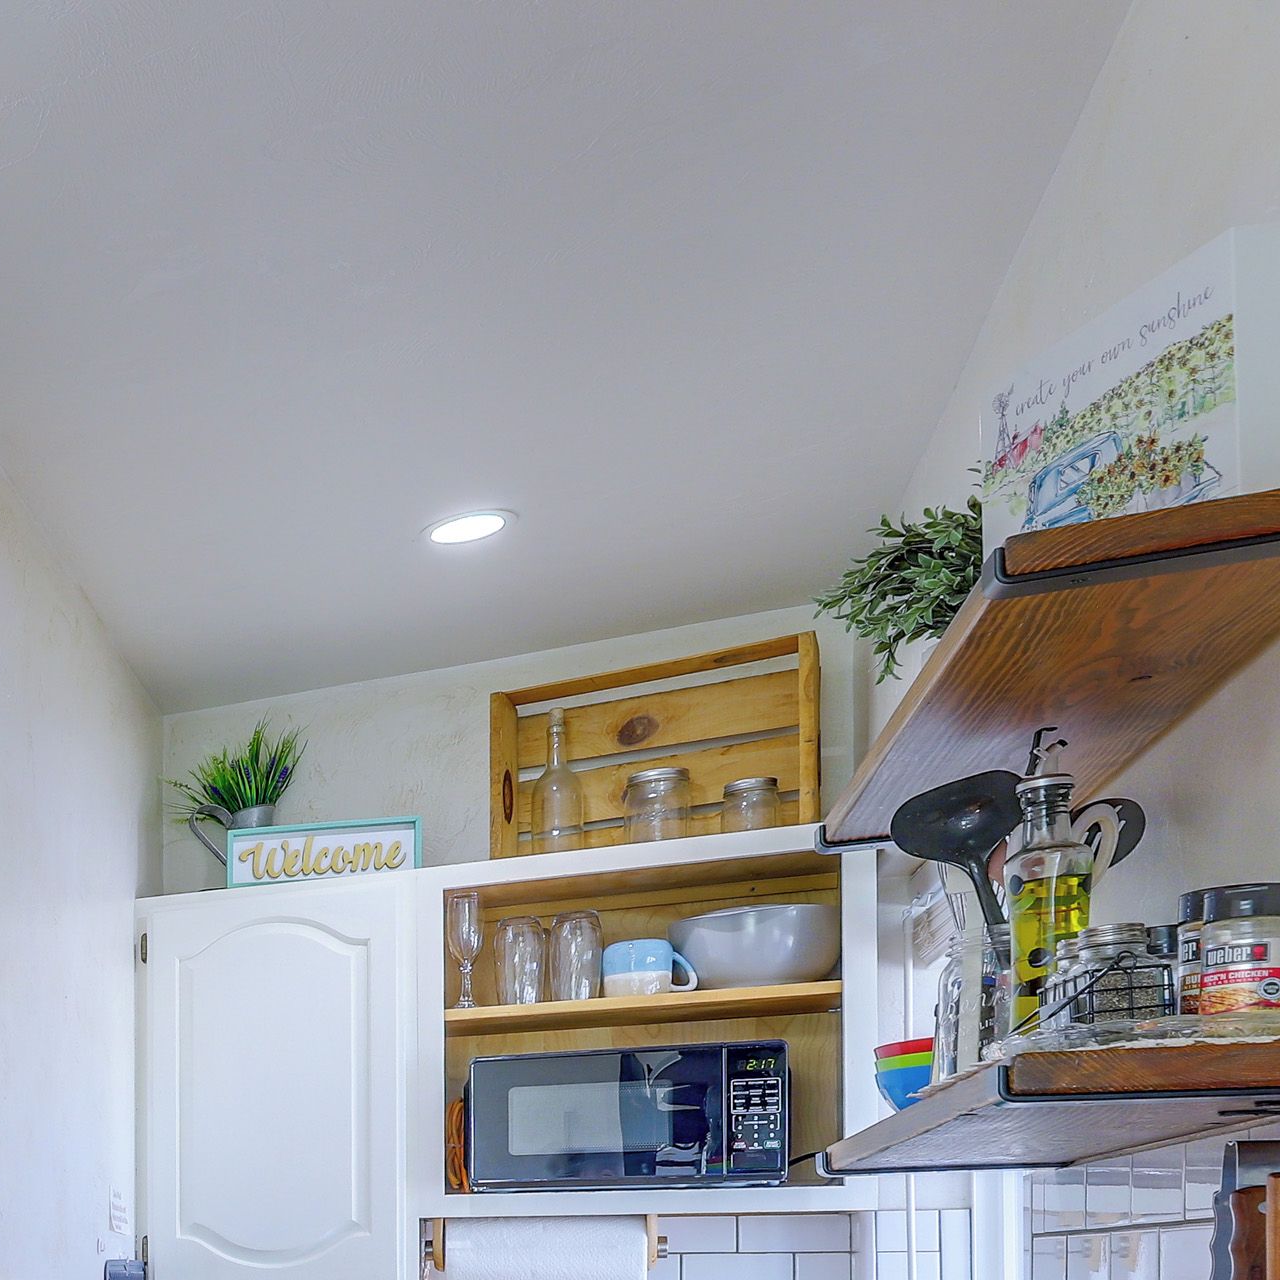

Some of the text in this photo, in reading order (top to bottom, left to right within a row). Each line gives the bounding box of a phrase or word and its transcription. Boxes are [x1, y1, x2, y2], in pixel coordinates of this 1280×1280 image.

[1062, 360, 1095, 398] your
[1100, 338, 1134, 364] own
[1139, 286, 1214, 347] sunshine
[239, 836, 406, 880] Welcome
[1207, 946, 1252, 966] weber
[1228, 969, 1269, 980] CHICKEN
[746, 1058, 775, 1070] 2:17
